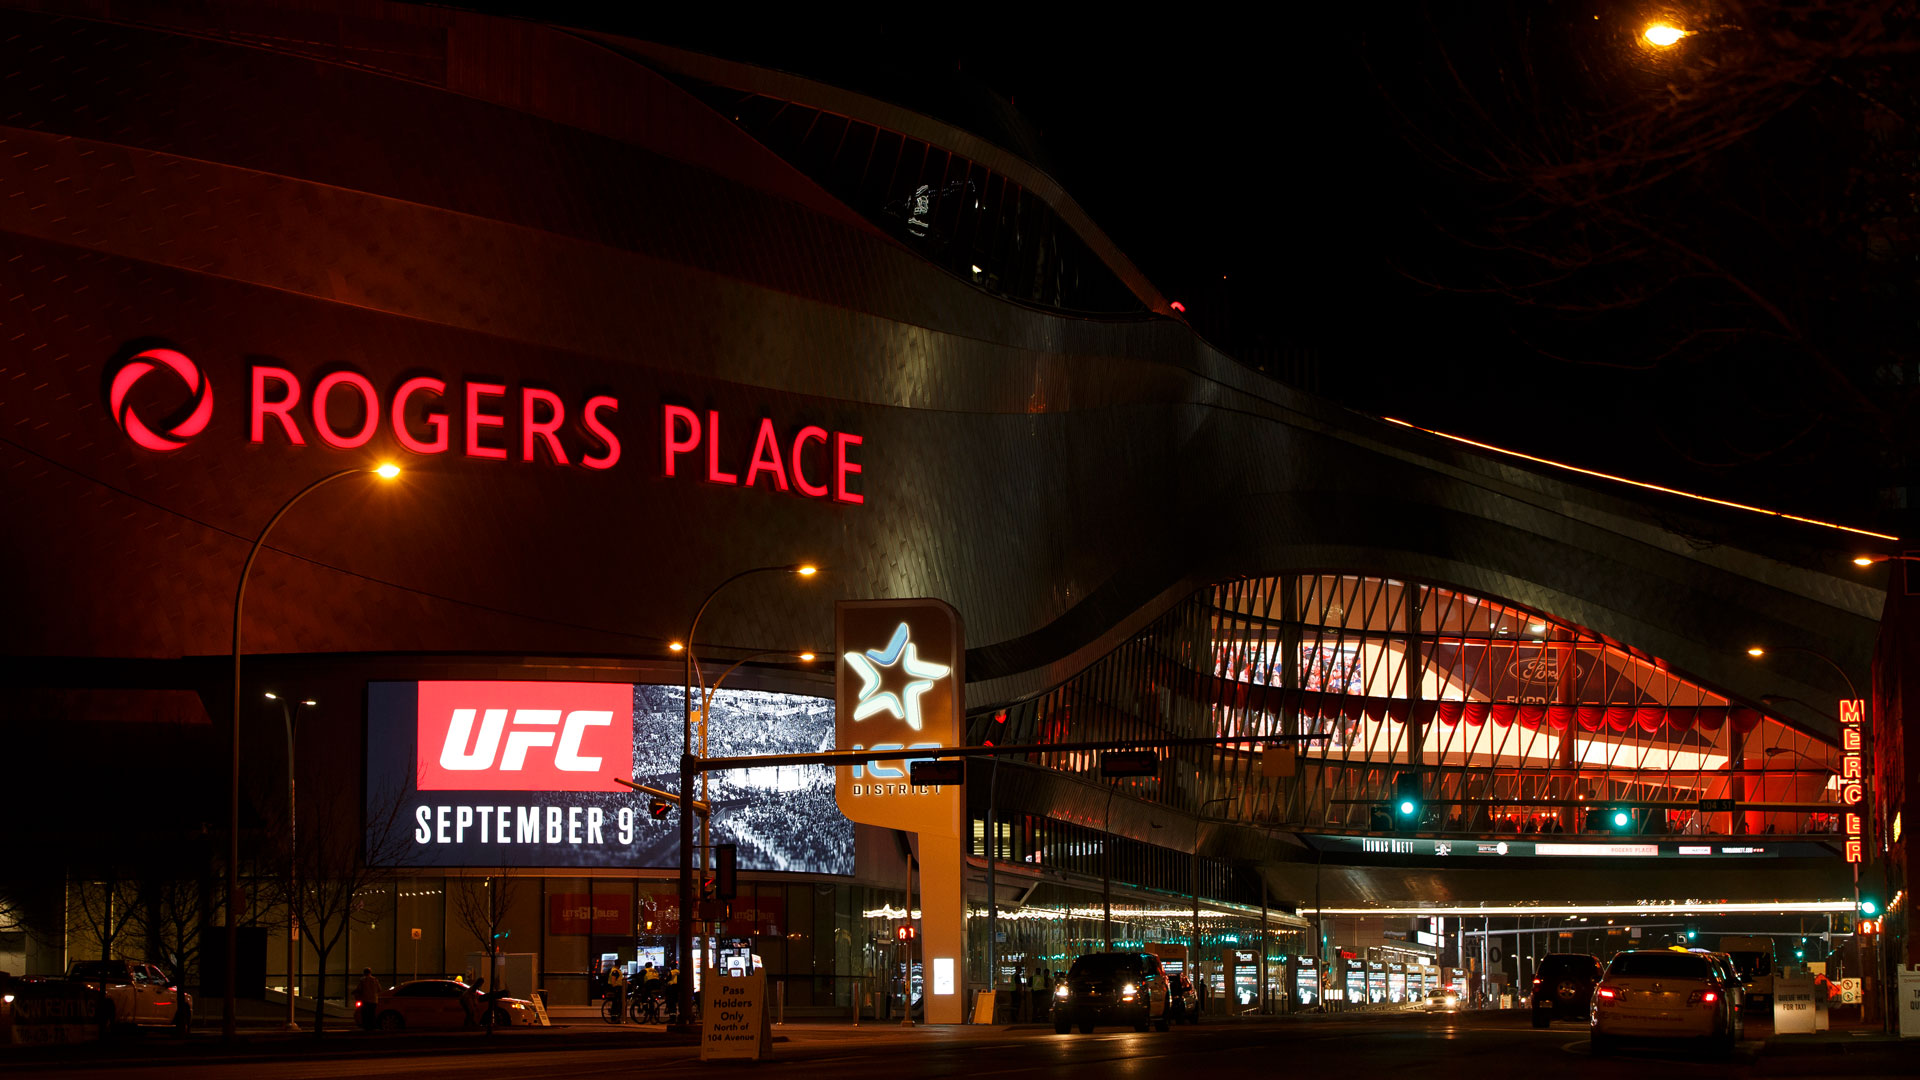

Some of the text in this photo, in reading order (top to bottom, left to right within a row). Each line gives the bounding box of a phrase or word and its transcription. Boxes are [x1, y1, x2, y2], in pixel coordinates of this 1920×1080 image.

[251, 364, 866, 506] ROGERS PLACE
[439, 708, 614, 773] UFC
[1839, 699, 1866, 863] MERCER
[415, 805, 639, 845] SEPTEMBER 9
[722, 986, 745, 996] Pass
[1778, 994, 1796, 1002] QUEUE
[1796, 994, 1811, 1002] HERE
[713, 999, 753, 1009] Holders
[1783, 1003, 1794, 1011] FOR
[1795, 1003, 1807, 1011] TAXI
[720, 1011, 744, 1023] Only
[713, 1022, 750, 1032] North of
[708, 1033, 755, 1042] 104 Avenue
